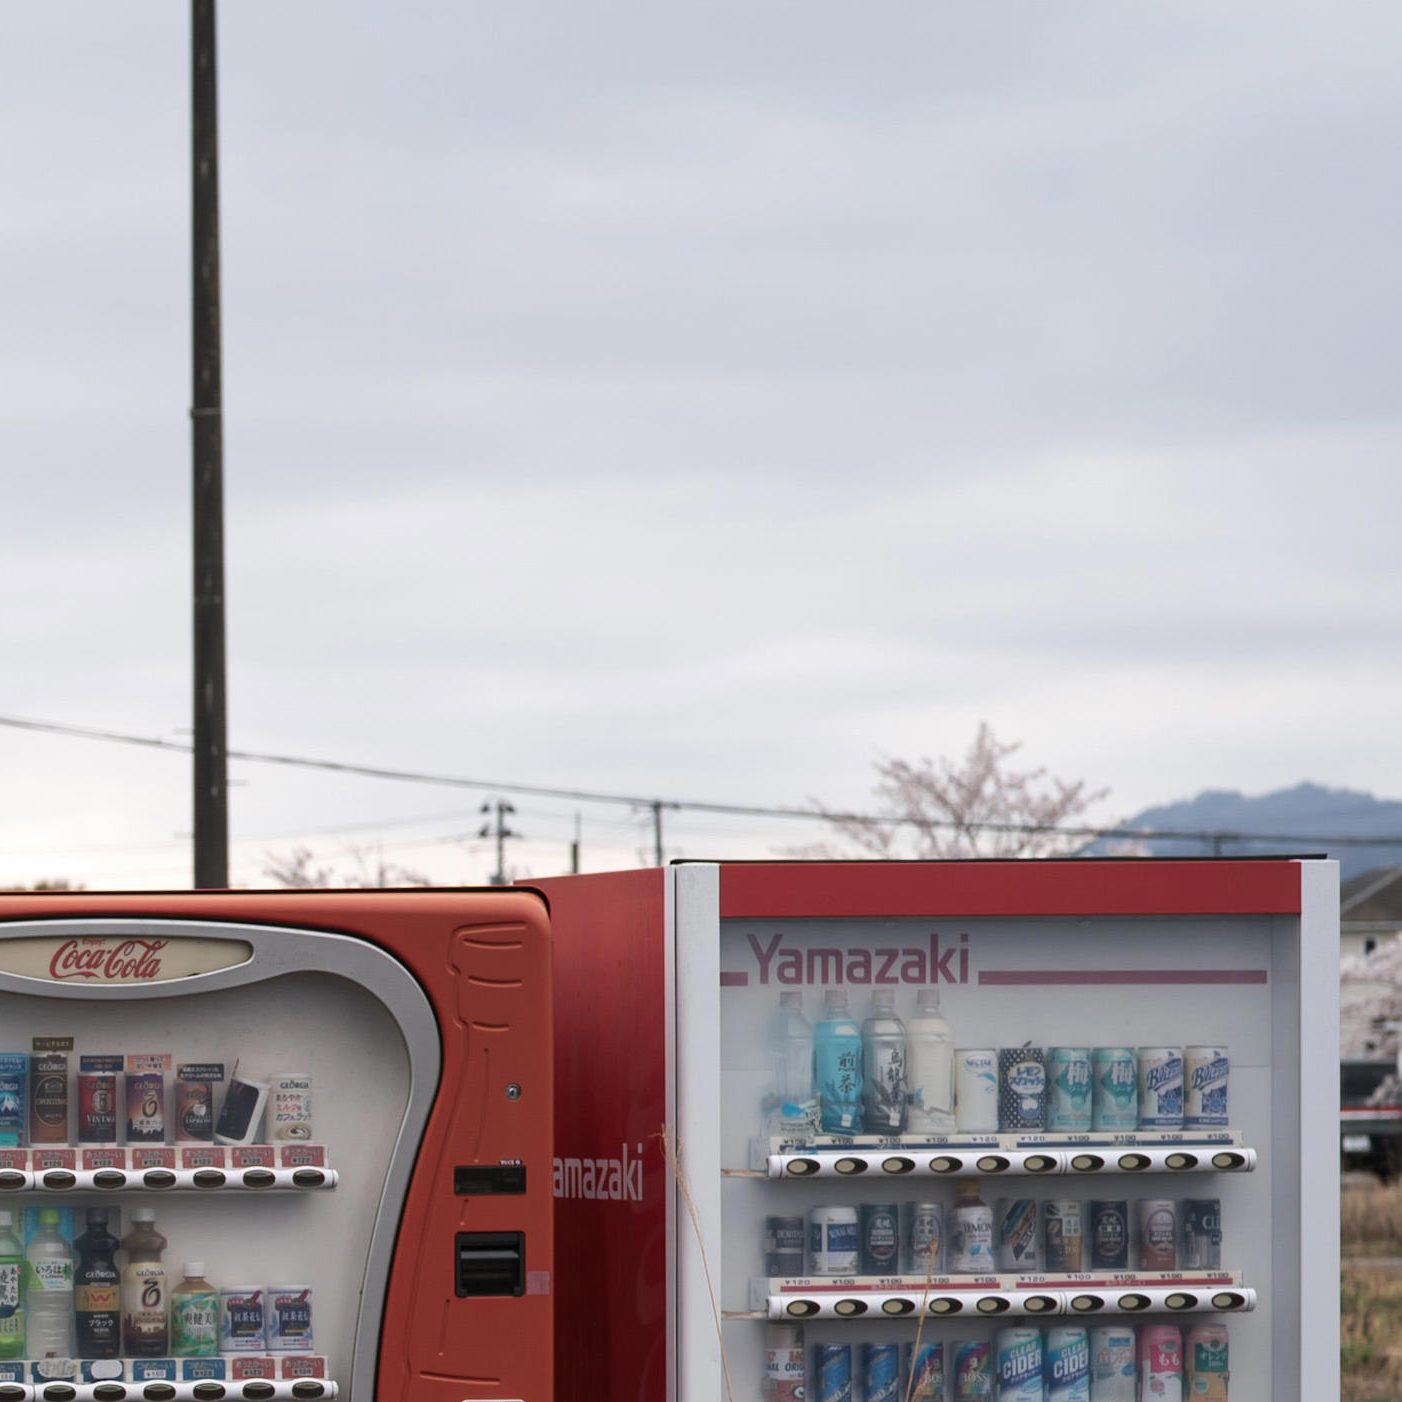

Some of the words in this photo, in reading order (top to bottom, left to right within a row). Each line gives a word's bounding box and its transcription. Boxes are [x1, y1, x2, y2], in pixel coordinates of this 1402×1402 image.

[49, 939, 169, 979] Coca-Cola
[747, 933, 969, 985] Yamazaki
[837, 1052, 856, 1095] 煎茶
[1016, 1066, 1042, 1075] レモン
[553, 1143, 643, 1200] amazaki
[87, 1319, 114, 1327] ブラック
[184, 1312, 213, 1326] 爽健美
[1010, 1341, 1037, 1358] CLEAR
[1158, 1353, 1180, 1366] もも
[1003, 1349, 1042, 1379] CIDER
